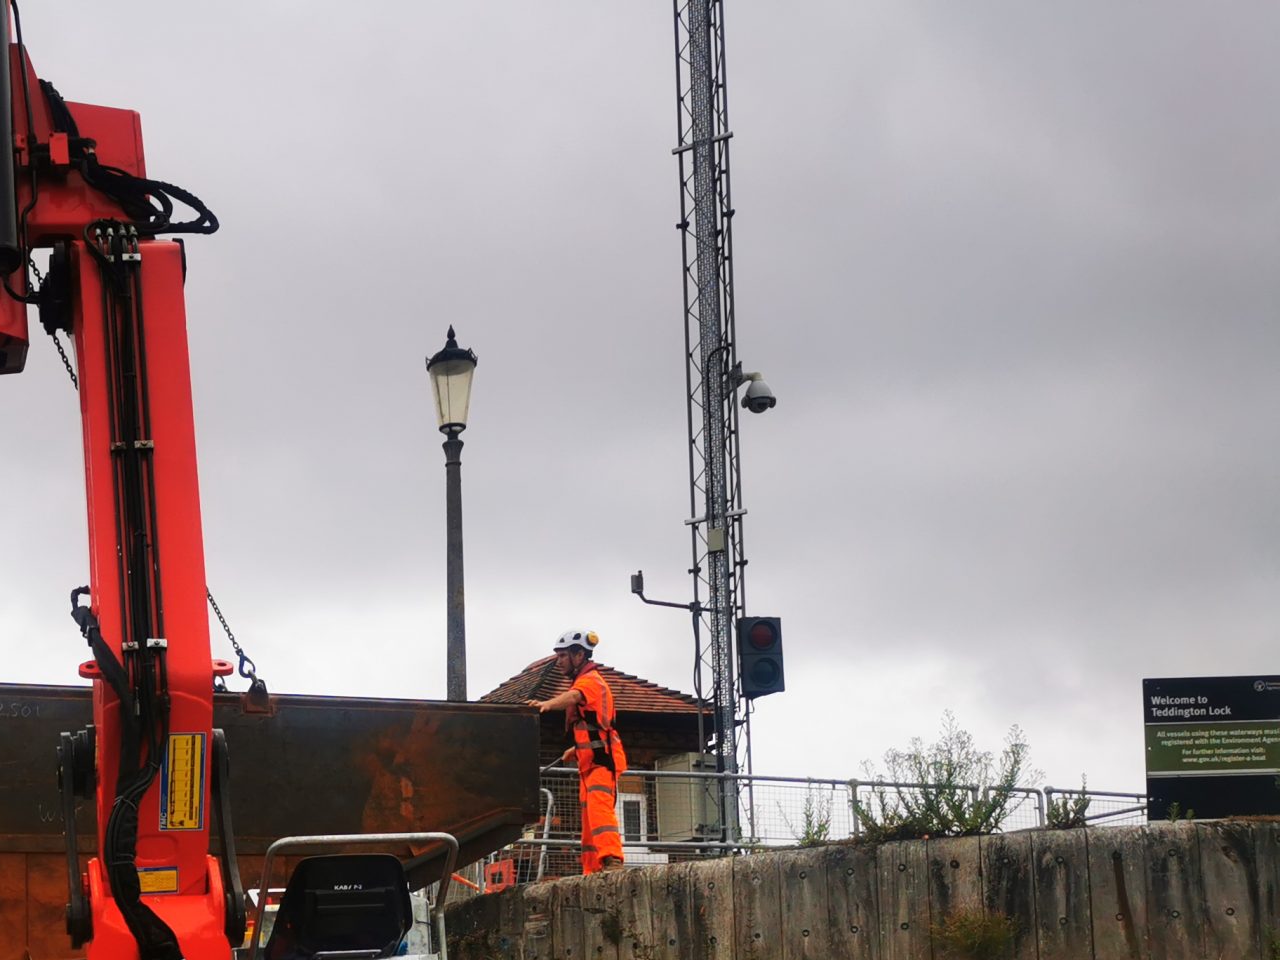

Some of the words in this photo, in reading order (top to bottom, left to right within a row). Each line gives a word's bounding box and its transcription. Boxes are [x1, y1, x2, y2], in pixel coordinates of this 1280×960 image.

[1151, 696, 1195, 705] Welcome
[1197, 696, 1208, 704] to
[1151, 707, 1207, 718] Teddington
[1208, 706, 1232, 716] Lock
